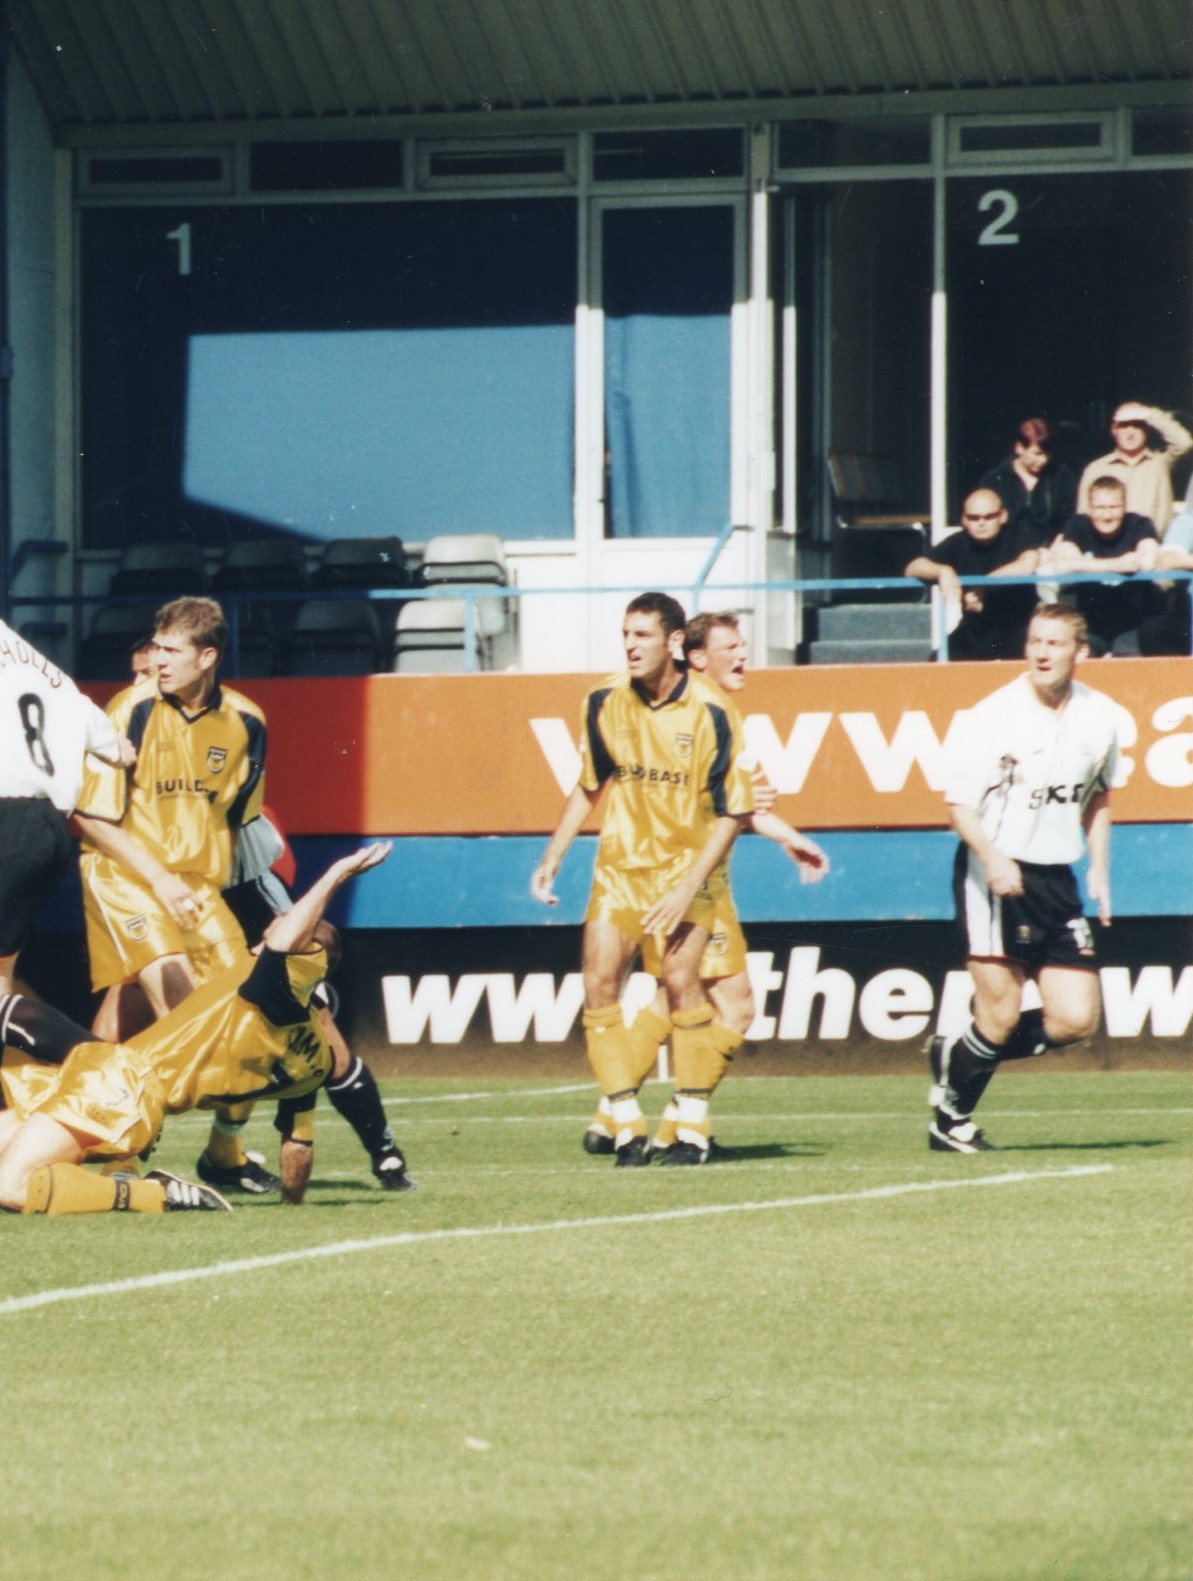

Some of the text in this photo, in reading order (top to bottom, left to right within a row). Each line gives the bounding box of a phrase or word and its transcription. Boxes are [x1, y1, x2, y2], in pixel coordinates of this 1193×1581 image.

[977, 188, 1019, 245] 2
[165, 222, 191, 275] 1
[17, 692, 55, 777] 8
